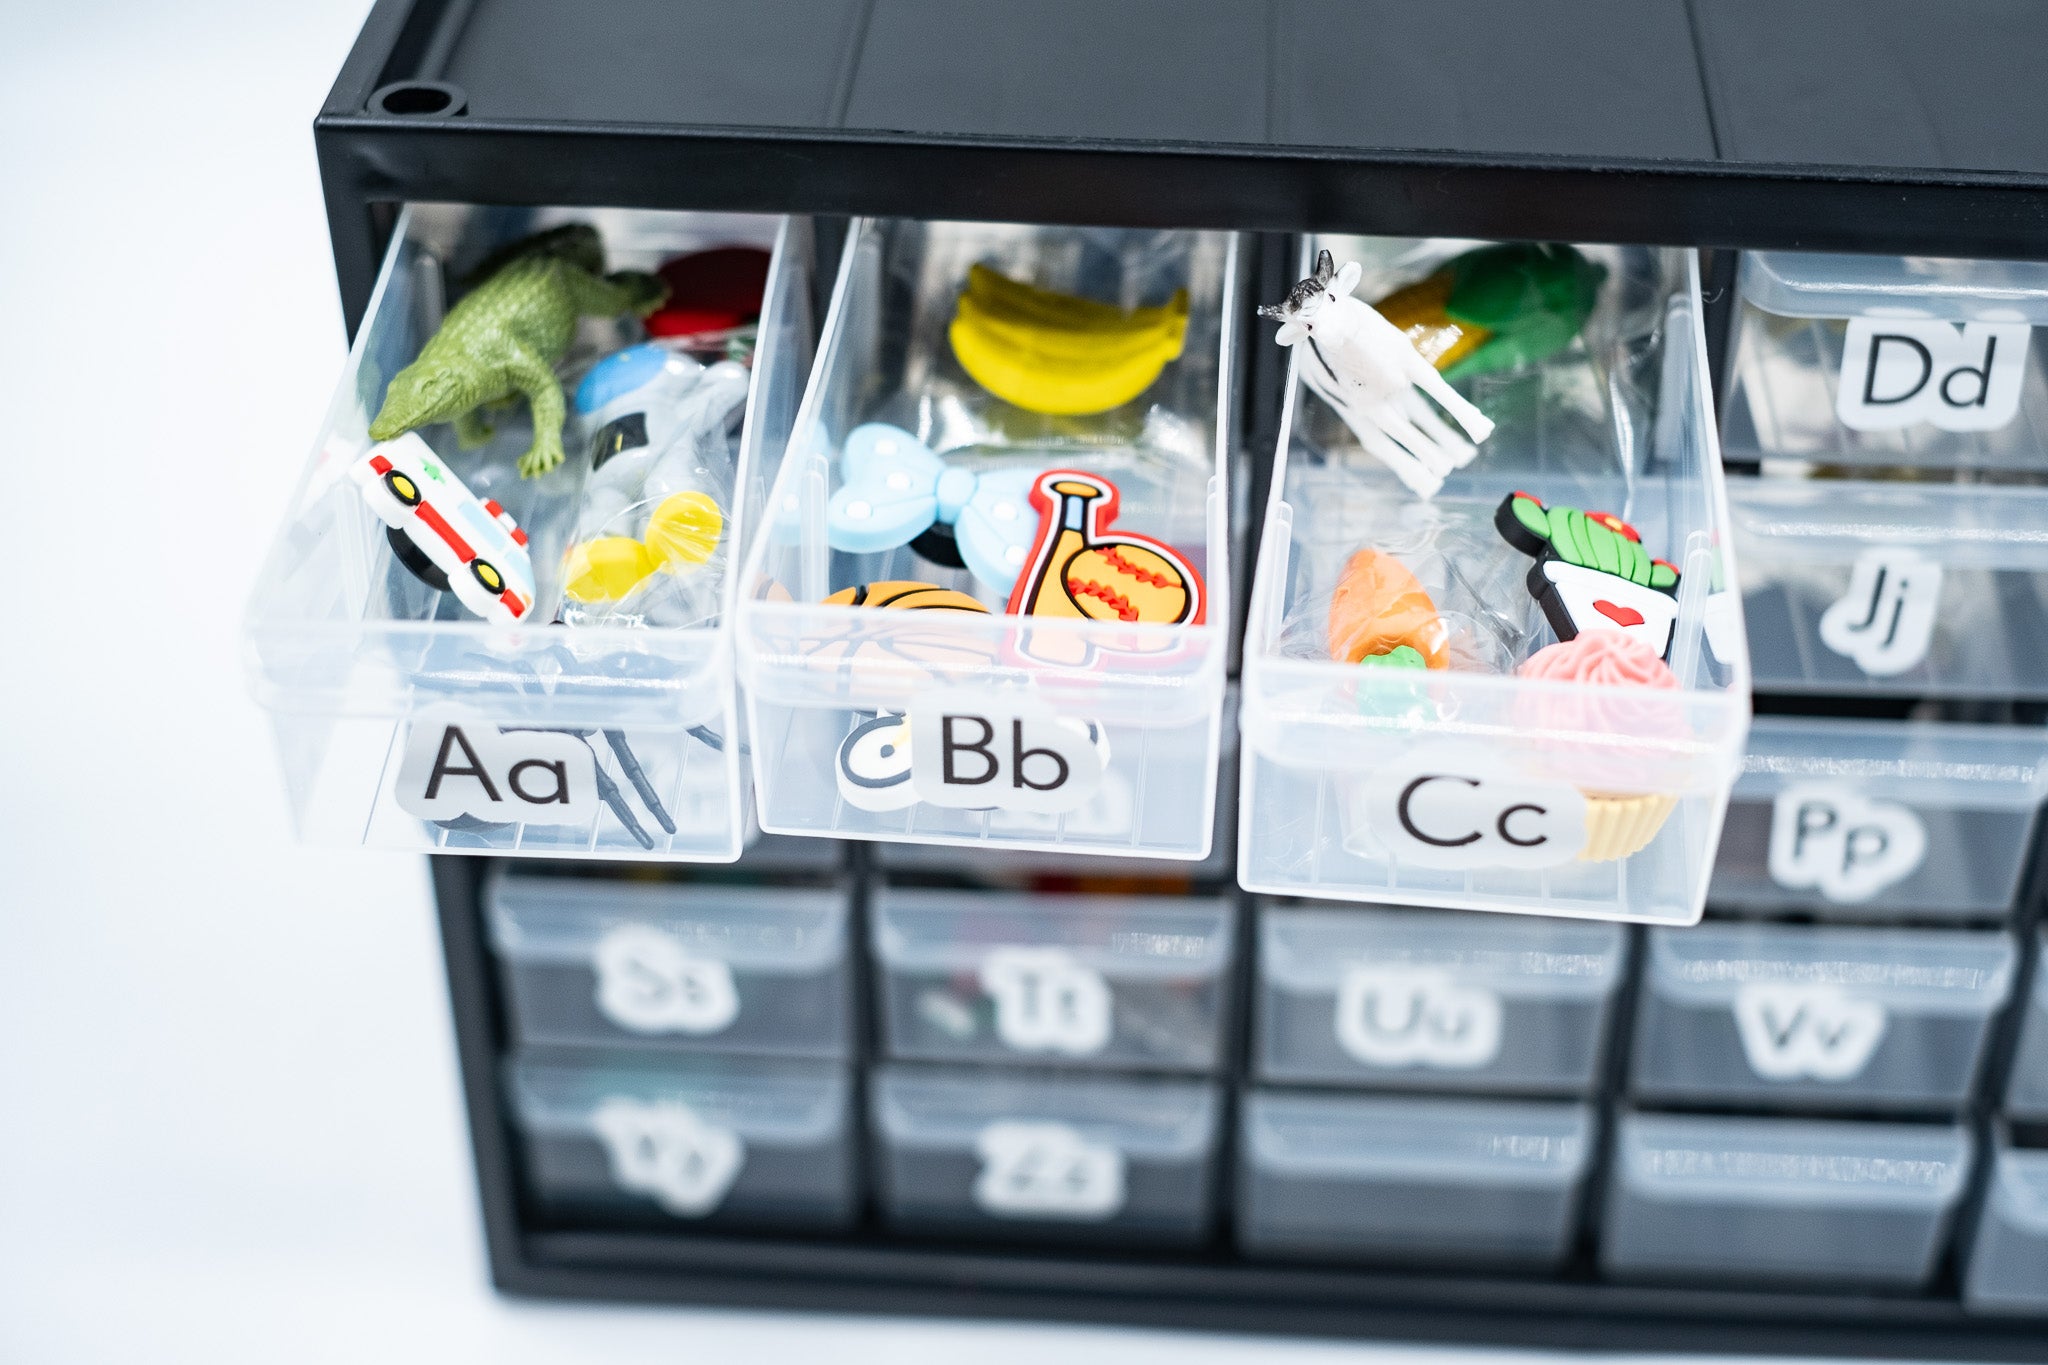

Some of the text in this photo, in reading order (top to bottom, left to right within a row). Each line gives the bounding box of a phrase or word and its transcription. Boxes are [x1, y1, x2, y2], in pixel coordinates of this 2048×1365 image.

[1863, 333, 1997, 408] Dd
[1847, 566, 1909, 649] Jj
[423, 724, 571, 805] Aa
[941, 715, 1070, 792] Bb
[1397, 774, 1549, 848] Cc
[1791, 803, 1891, 876] Pp
